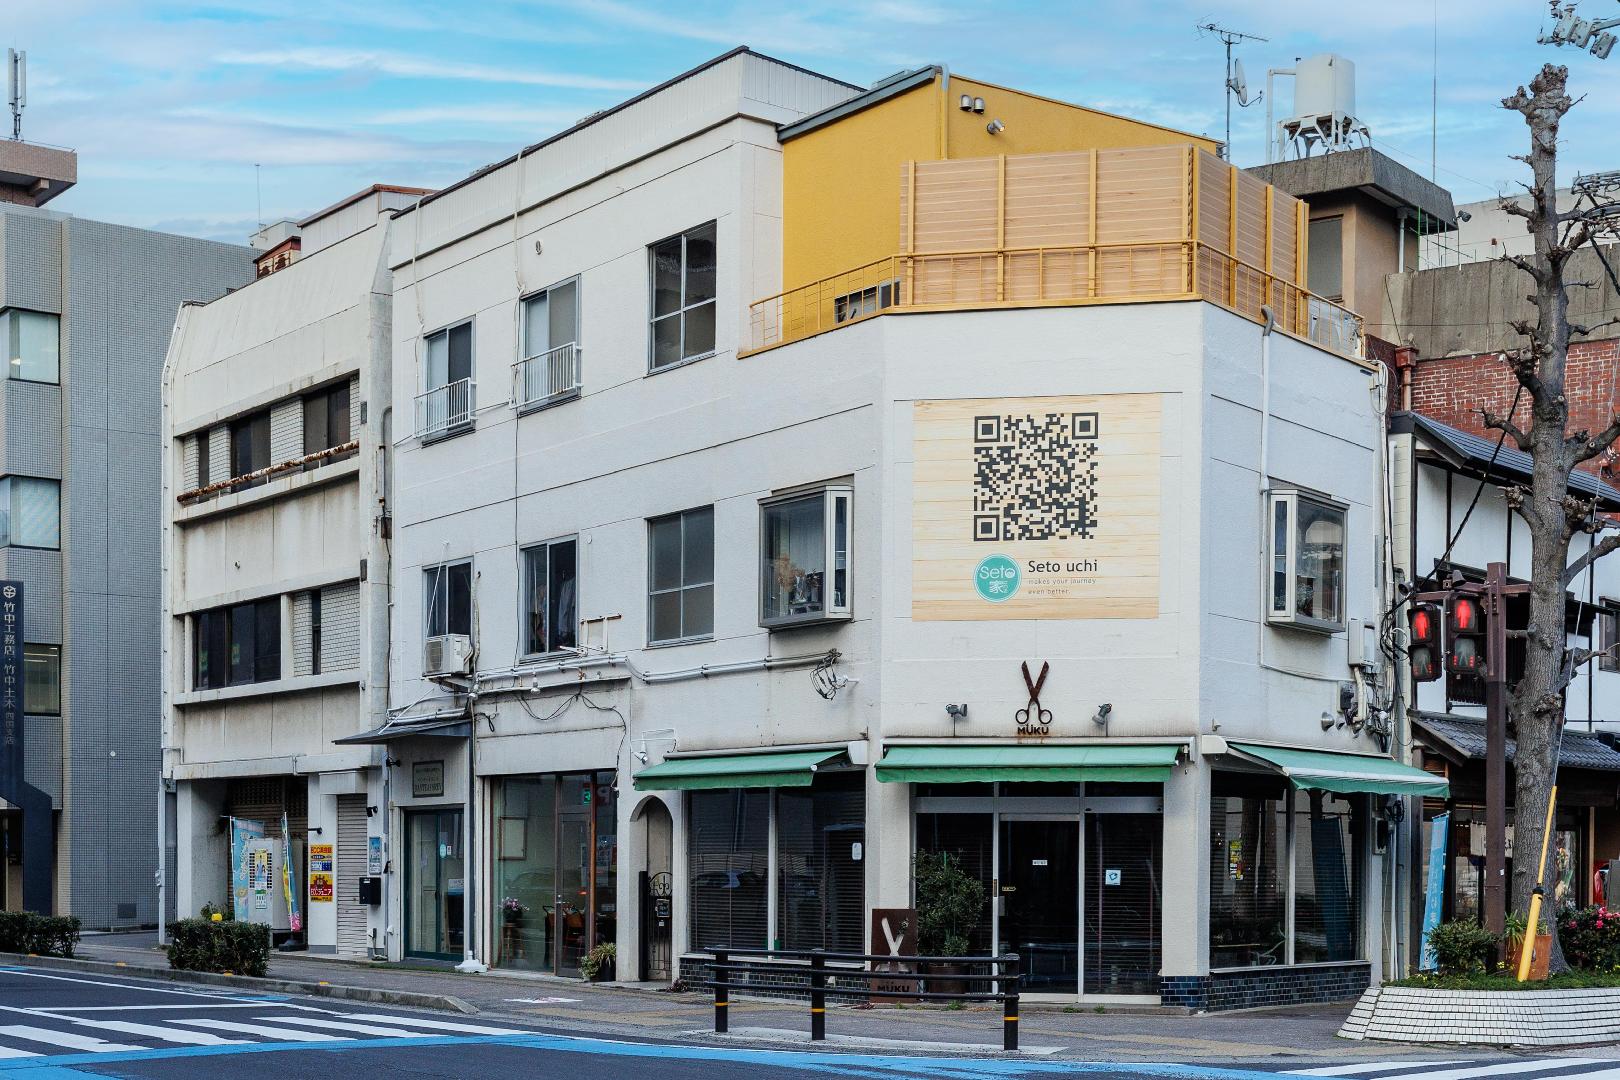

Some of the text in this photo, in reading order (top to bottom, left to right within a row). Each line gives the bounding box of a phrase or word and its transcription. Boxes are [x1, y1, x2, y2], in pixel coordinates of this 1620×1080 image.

[979, 564, 1016, 579] Seto
[1028, 559, 1098, 573] Seto uchi
[1052, 578, 1068, 586] your
